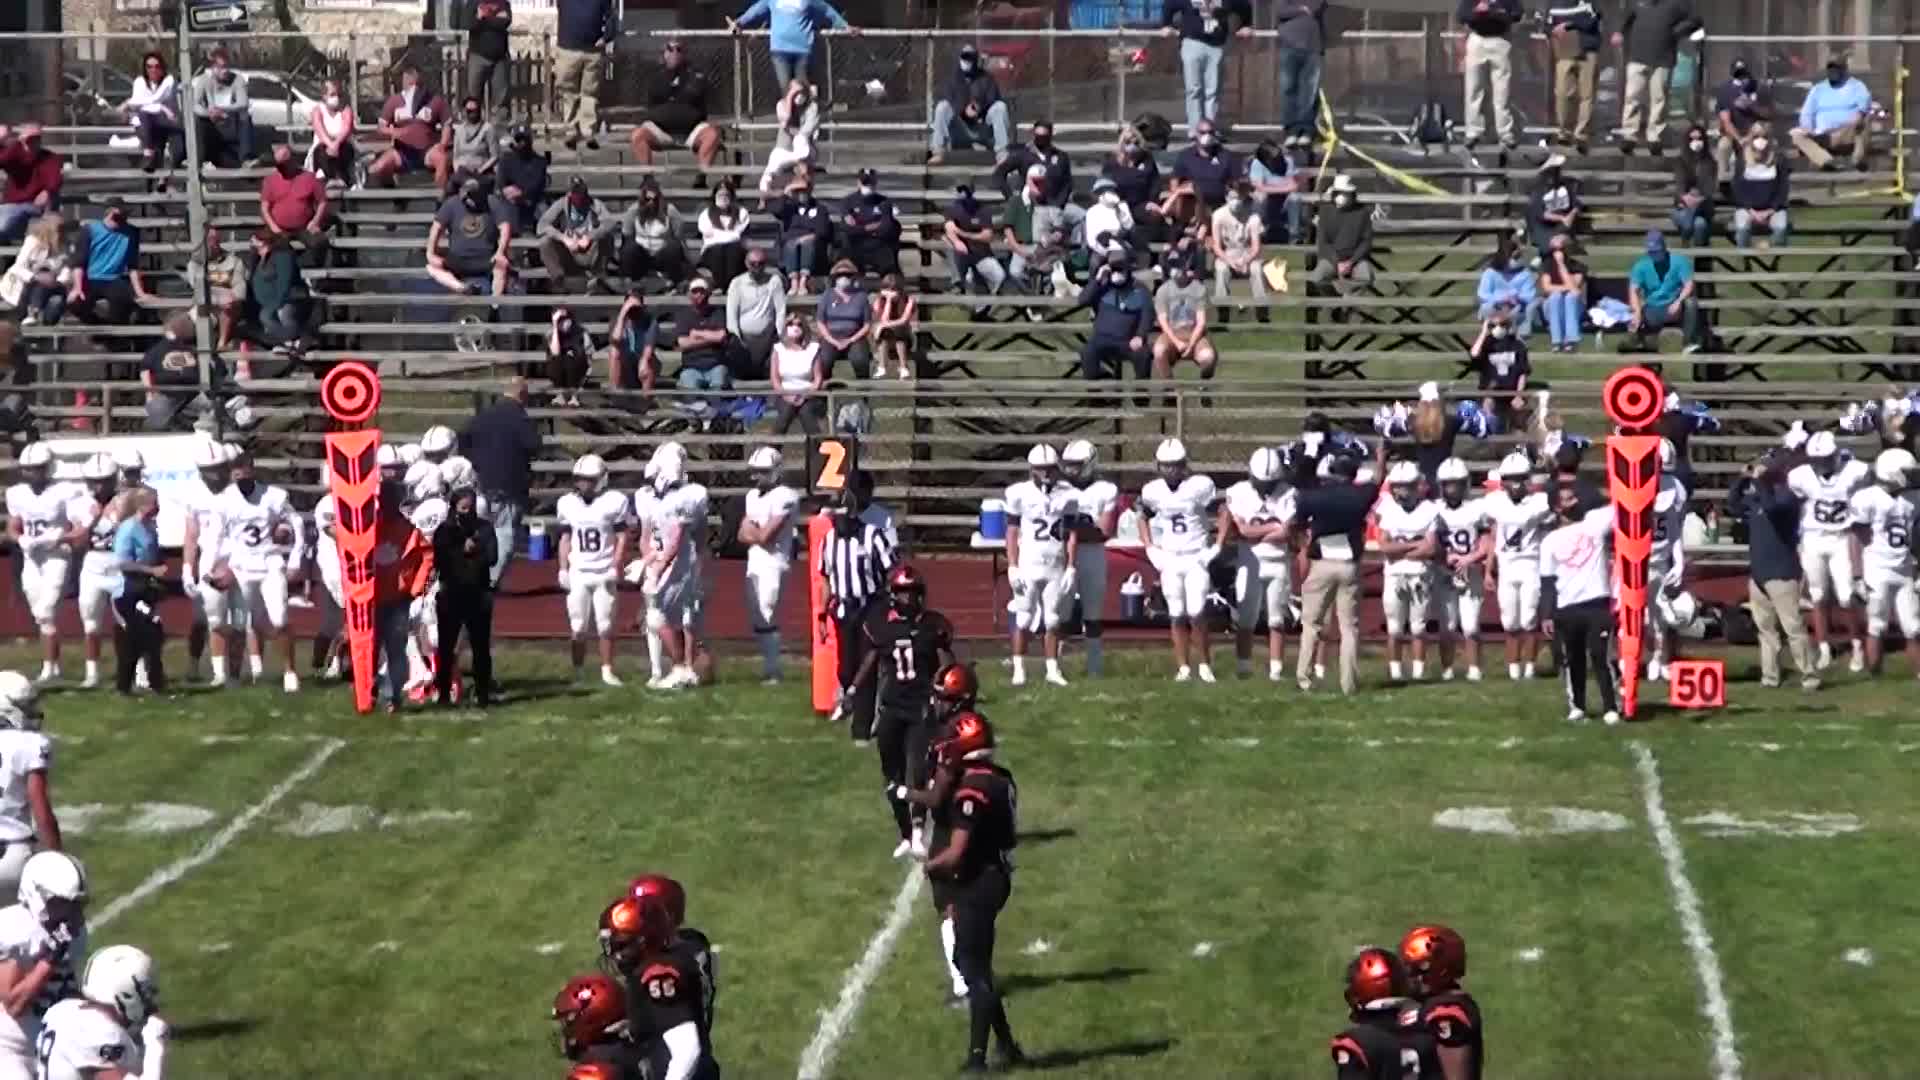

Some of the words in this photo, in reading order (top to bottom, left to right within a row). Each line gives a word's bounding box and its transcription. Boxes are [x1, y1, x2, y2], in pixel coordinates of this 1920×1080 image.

[816, 440, 846, 488] 2
[1814, 499, 1848, 524] 62
[243, 525, 261, 547] 3
[578, 527, 601, 552] 18
[892, 647, 916, 681] 11
[1678, 666, 1719, 702] 50
